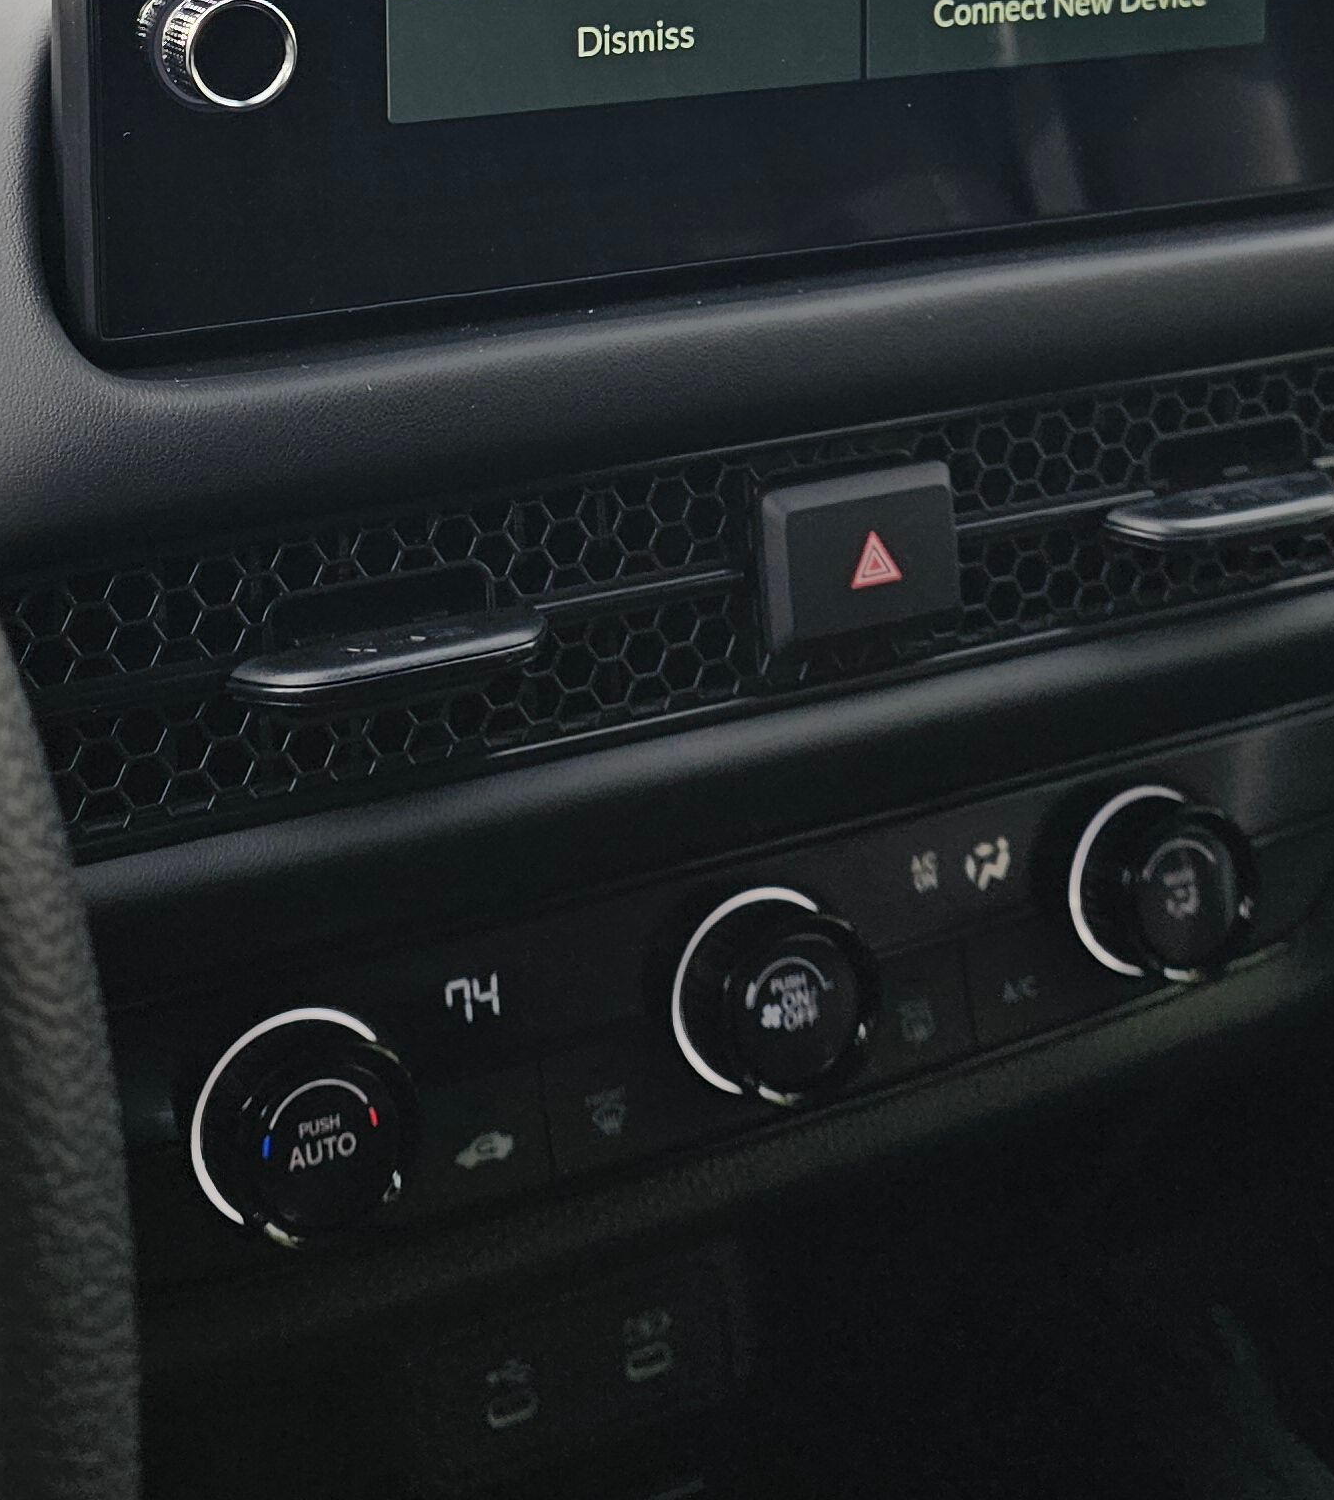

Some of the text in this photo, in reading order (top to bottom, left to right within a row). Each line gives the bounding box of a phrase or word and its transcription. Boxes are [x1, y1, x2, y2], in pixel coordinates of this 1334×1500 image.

[577, 20, 696, 58] Dismiss
[445, 971, 501, 1022] 74
[298, 1112, 342, 1137] PUSH
[288, 1131, 357, 1172] AUTO
